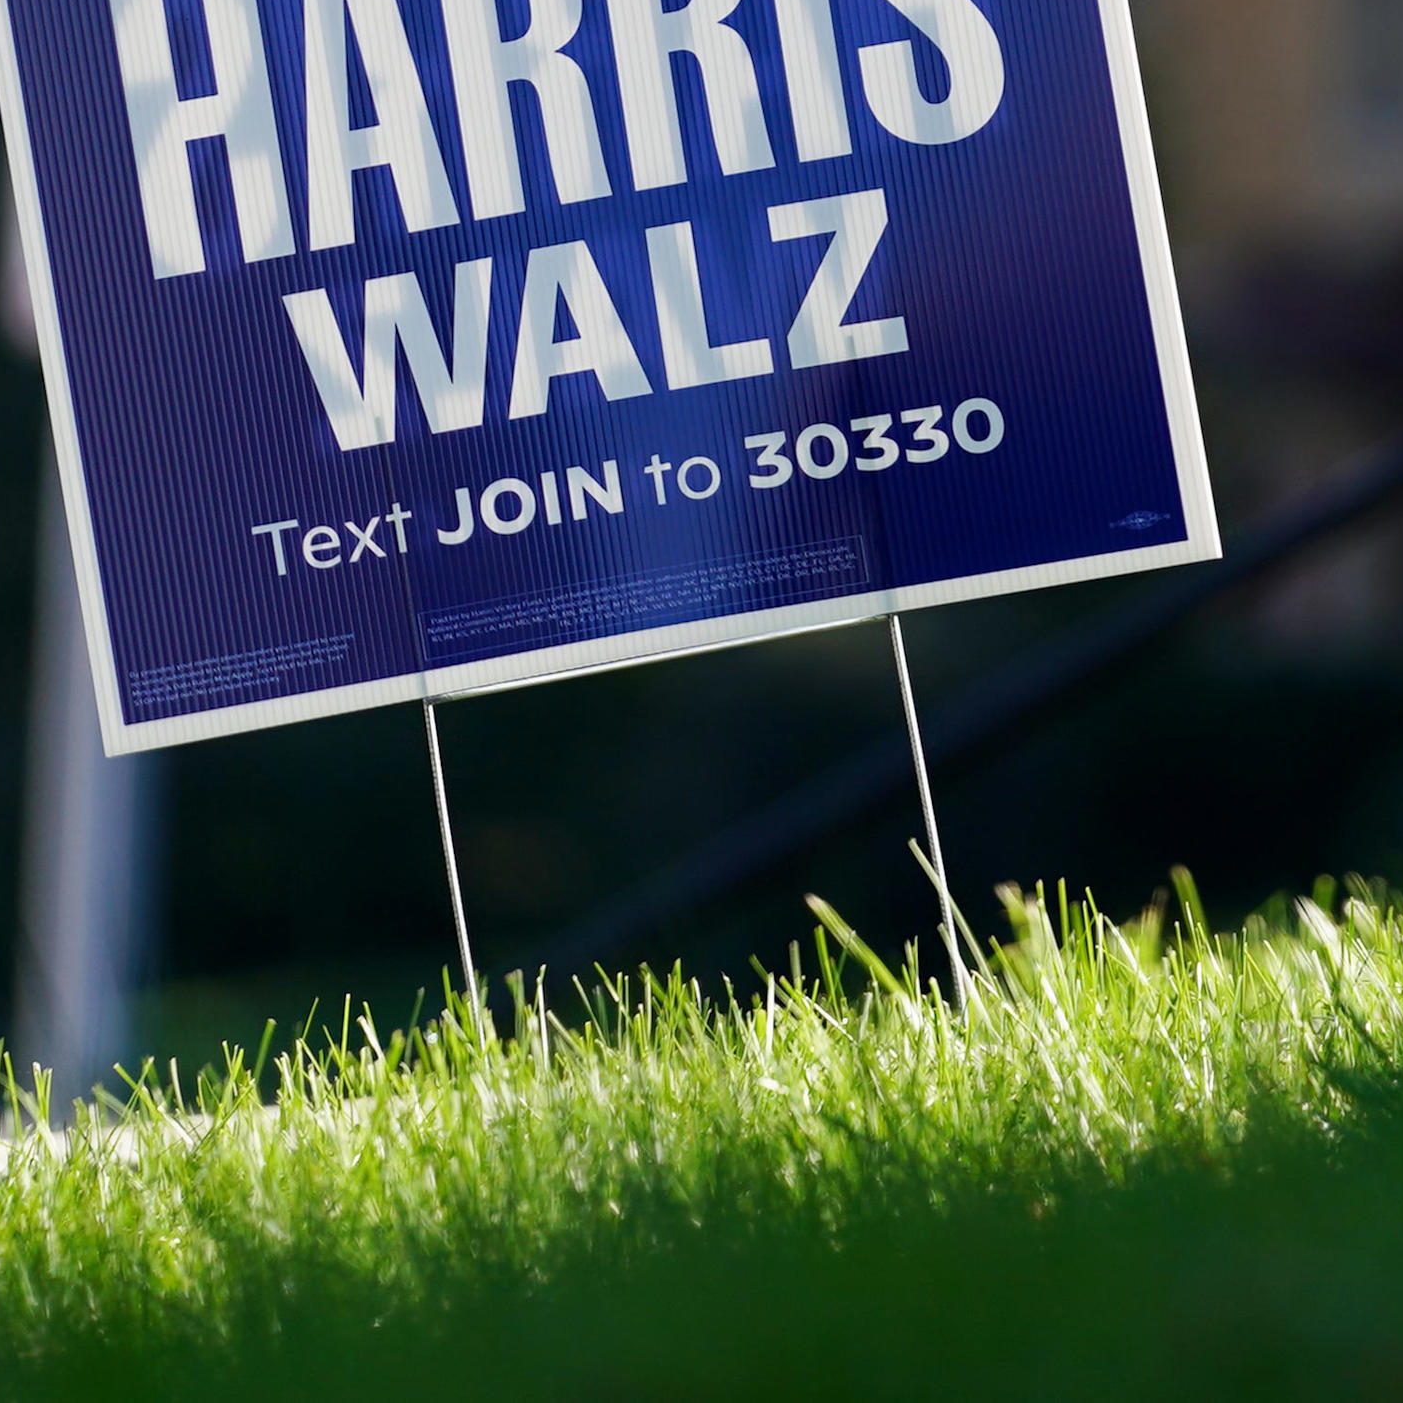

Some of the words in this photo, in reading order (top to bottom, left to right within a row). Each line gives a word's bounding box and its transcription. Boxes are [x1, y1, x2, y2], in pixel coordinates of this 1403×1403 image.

[281, 188, 909, 450] WALZ
[251, 500, 413, 579] Text
[436, 458, 625, 546] JOIN
[644, 449, 722, 507] to
[746, 396, 1005, 490] 30330
